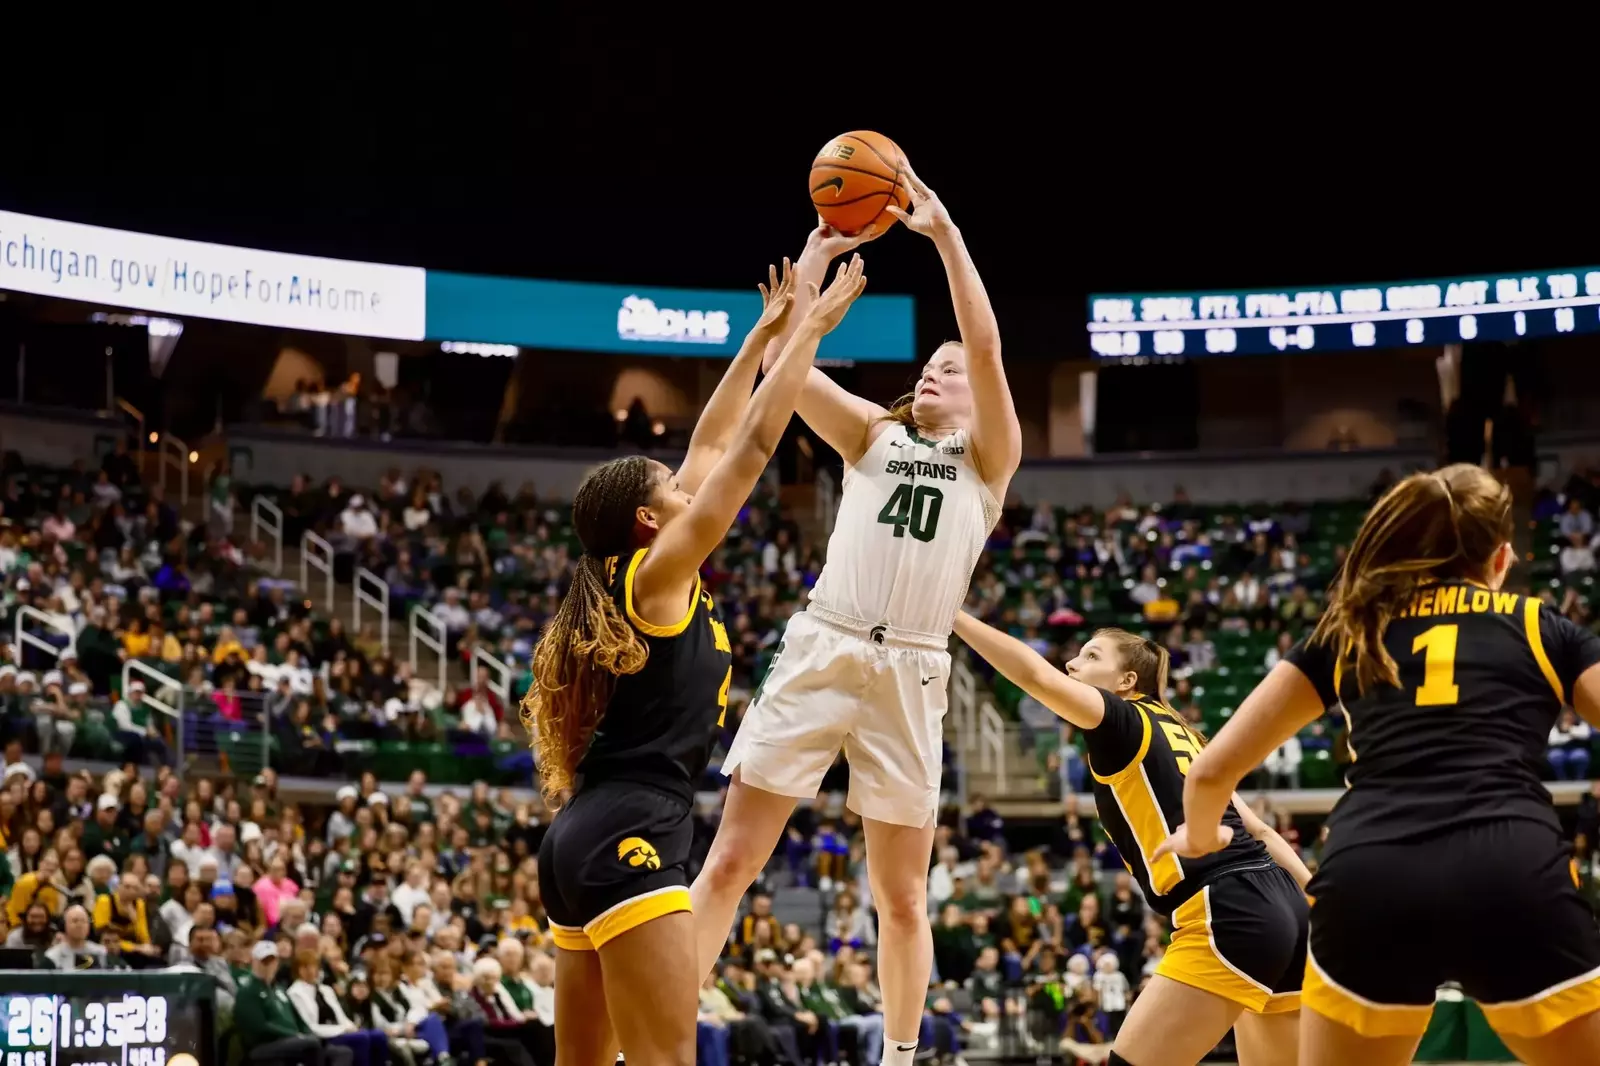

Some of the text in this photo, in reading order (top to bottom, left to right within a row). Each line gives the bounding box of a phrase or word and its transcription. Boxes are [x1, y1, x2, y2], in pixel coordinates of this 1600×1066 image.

[877, 483, 944, 543] 40
[1411, 624, 1459, 706] 1
[8, 997, 53, 1046] 26
[60, 1003, 125, 1047] 1:35
[125, 996, 167, 1043] 28
